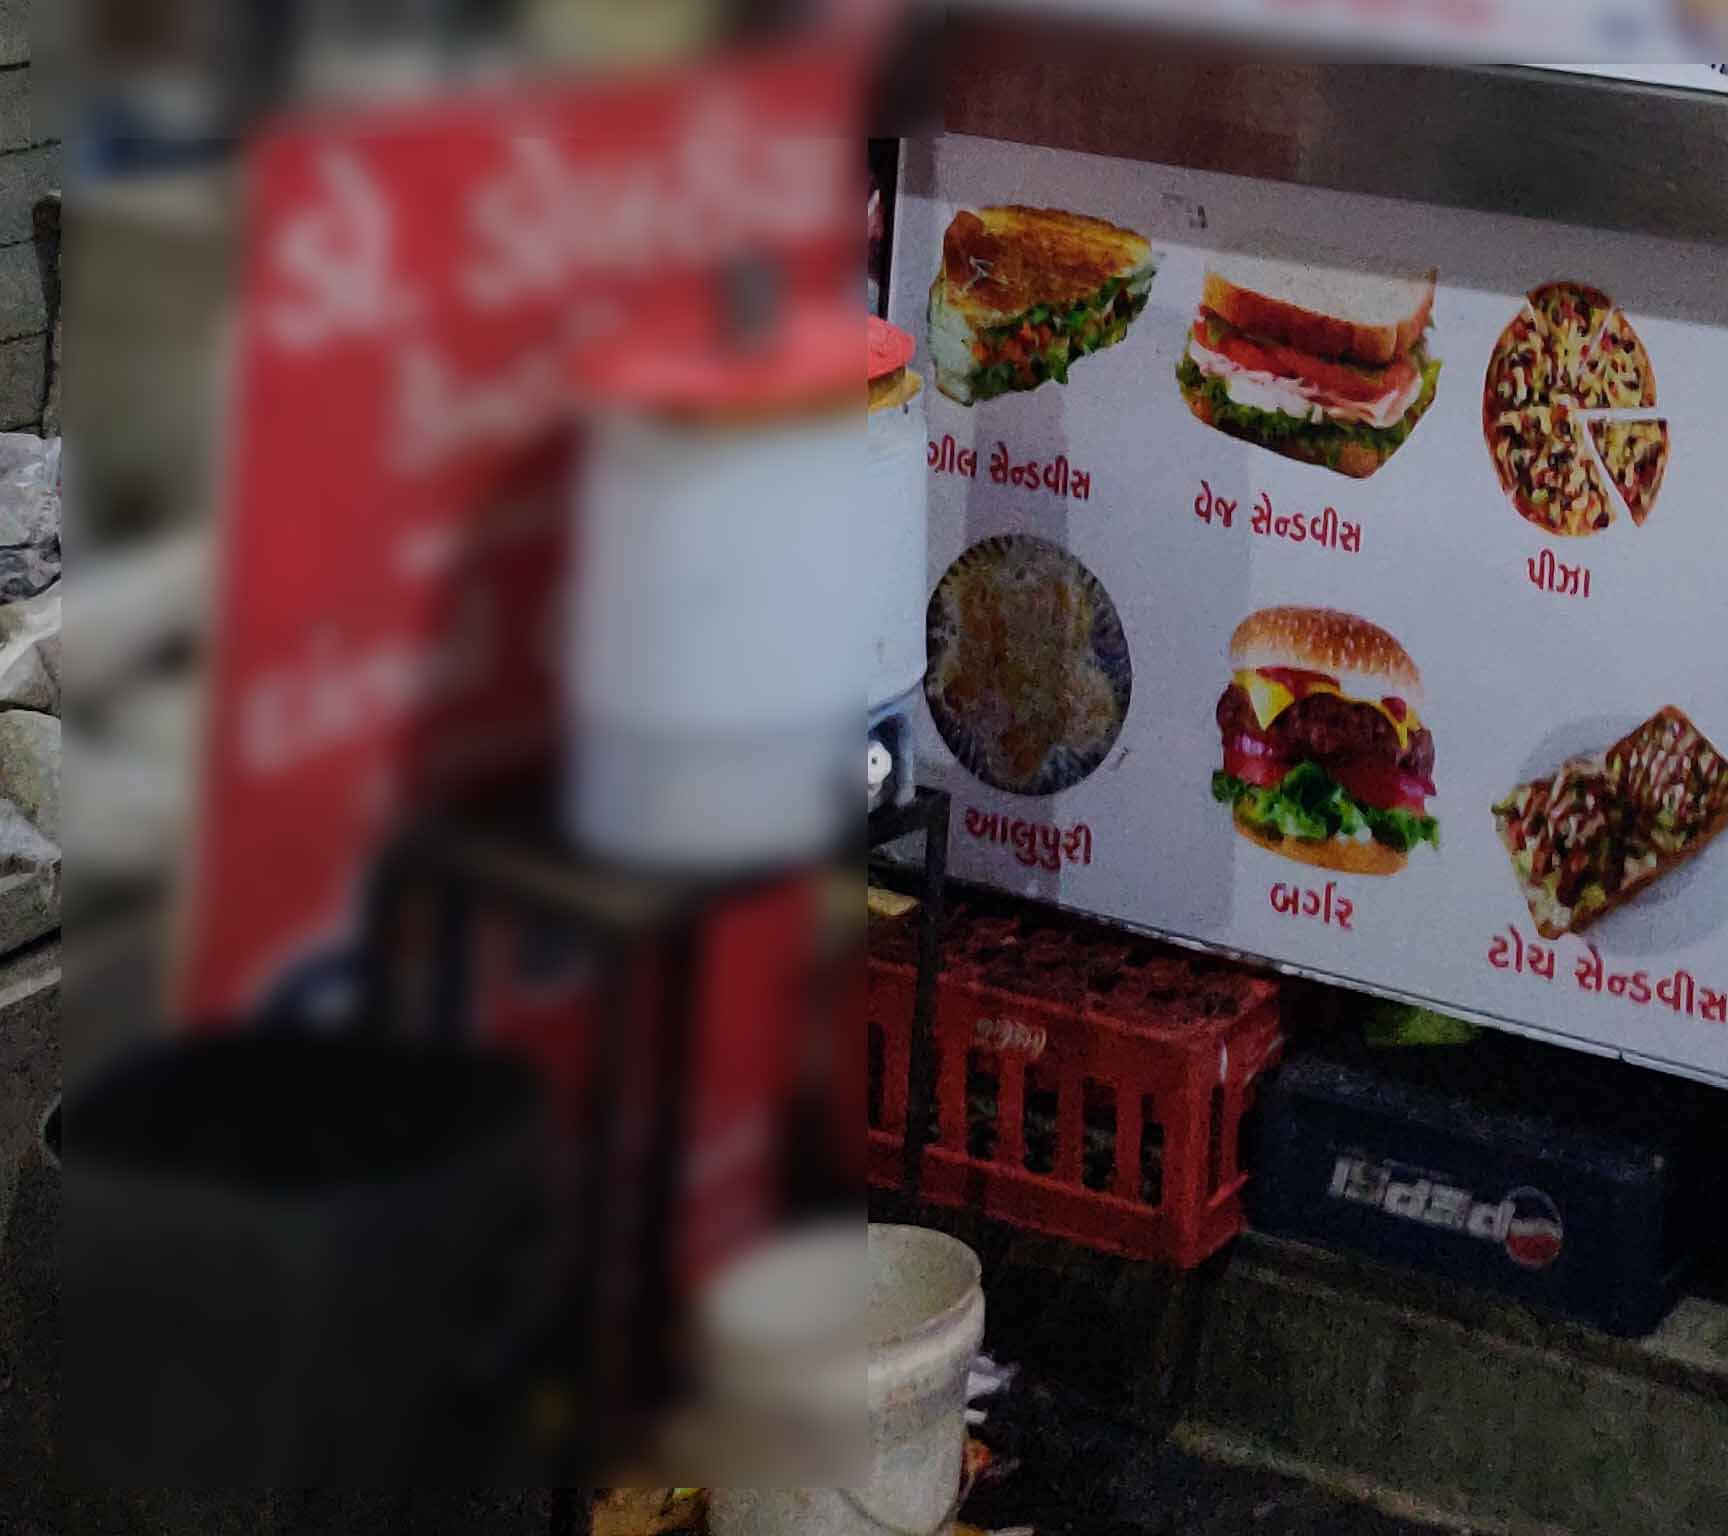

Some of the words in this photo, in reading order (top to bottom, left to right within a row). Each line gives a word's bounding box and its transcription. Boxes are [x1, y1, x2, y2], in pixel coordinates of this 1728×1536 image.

[1194, 480, 1239, 529] વેજ
[1250, 492, 1362, 553] સેન્ડવીસ
[1527, 548, 1591, 599] પીઝા
[964, 807, 1093, 875] આલુપુરી
[1268, 880, 1354, 930] બર્ગર
[1572, 948, 1728, 1025] સેન્ડવીસ
